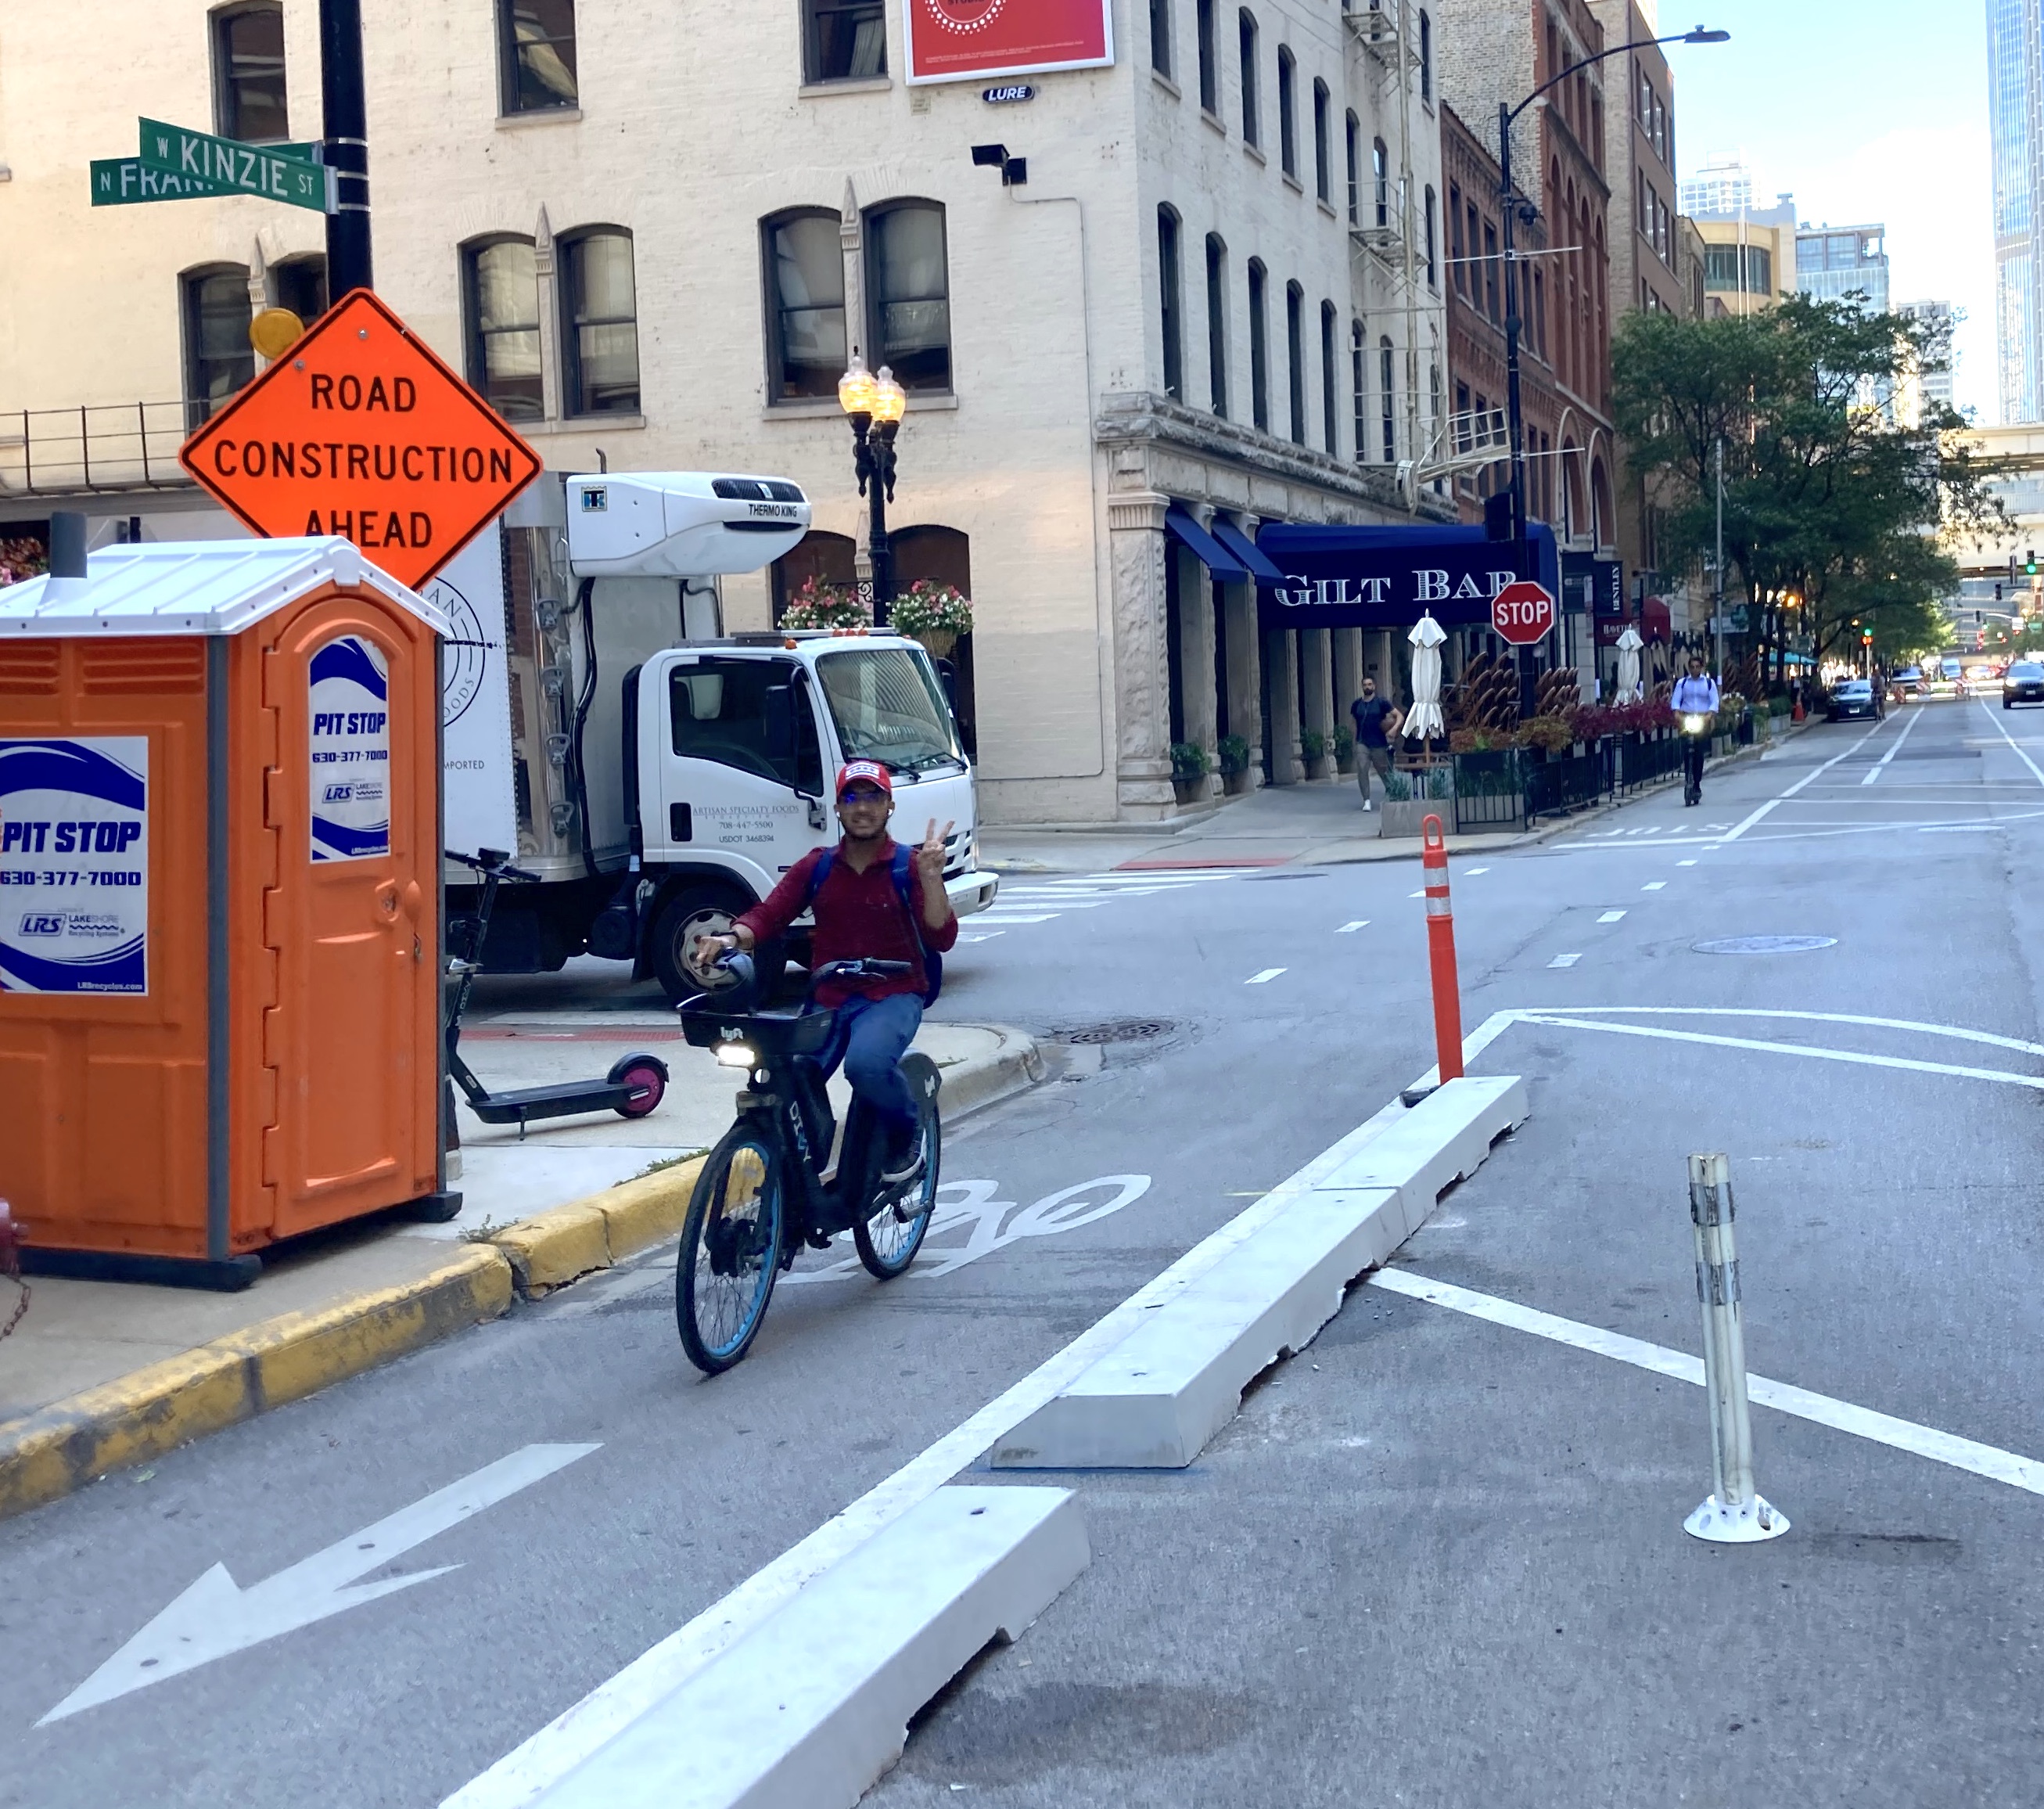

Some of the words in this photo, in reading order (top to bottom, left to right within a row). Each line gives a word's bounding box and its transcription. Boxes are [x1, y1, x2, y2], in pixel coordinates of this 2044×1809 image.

[988, 86, 1027, 101] LURE
[157, 137, 168, 159] W
[181, 135, 288, 196] KINZIE
[298, 174, 313, 196] ST
[101, 172, 110, 191] N
[311, 373, 416, 412] ROAD
[214, 439, 512, 484] CONSTRUCTION
[748, 503, 781, 517] THERMO
[781, 505, 797, 517] KING
[305, 509, 433, 548] AHEAD
[1275, 575, 1391, 606] GILT
[1496, 601, 1549, 626] STOP
[444, 678, 474, 717] OODS
[314, 713, 345, 735] PIT
[347, 713, 386, 734] STOP
[312, 750, 387, 763] 630-377-7000
[444, 760, 485, 770] MPORTED
[325, 787, 351, 800] LRS
[693, 807, 727, 815] ARTISAN
[2, 822, 51, 853] PIT
[55, 822, 142, 853] STOP
[0, 871, 142, 886] 630-377-7000
[23, 917, 63, 933] LRS
[720, 1027, 744, 1041] lyft
